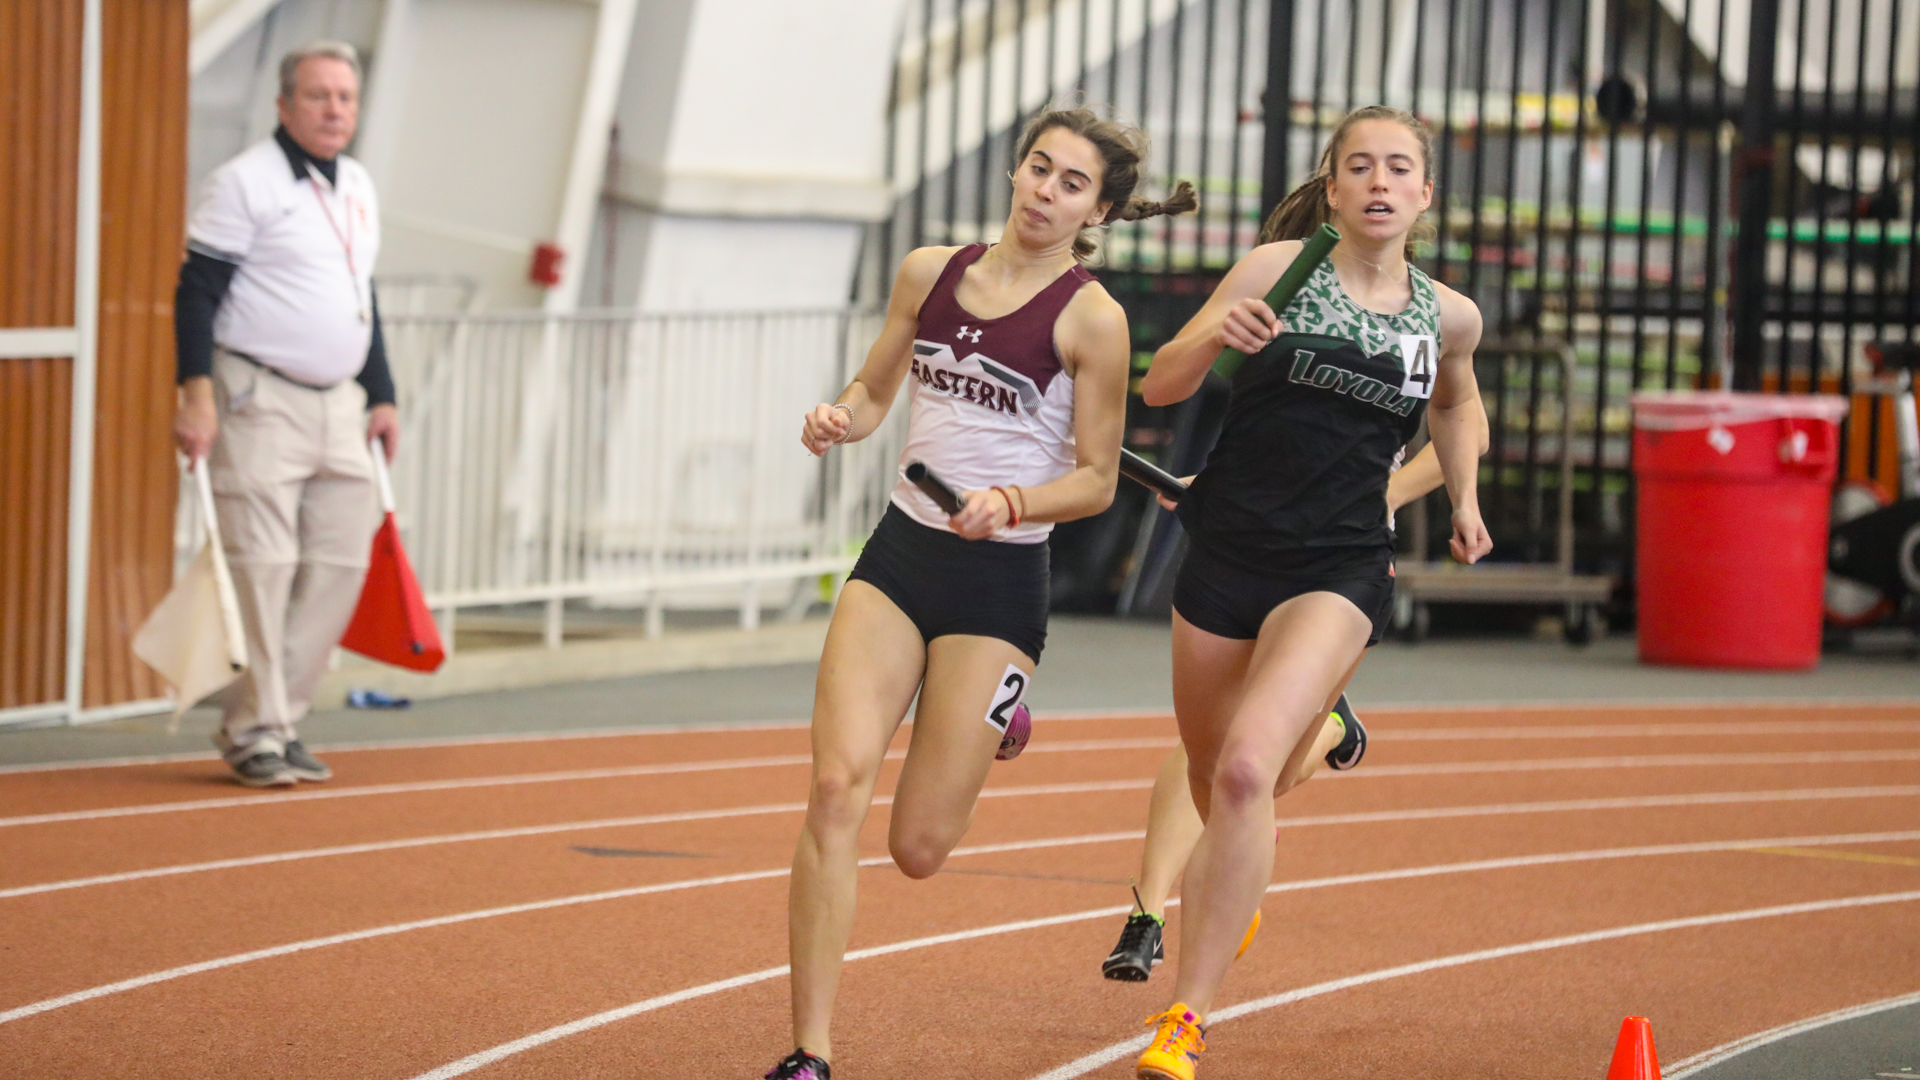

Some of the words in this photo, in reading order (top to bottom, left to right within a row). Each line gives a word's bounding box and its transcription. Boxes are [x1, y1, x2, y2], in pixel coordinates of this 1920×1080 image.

[1288, 349, 1418, 417] LOYOLA
[1409, 340, 1432, 394] 4
[990, 673, 1025, 729] 2
